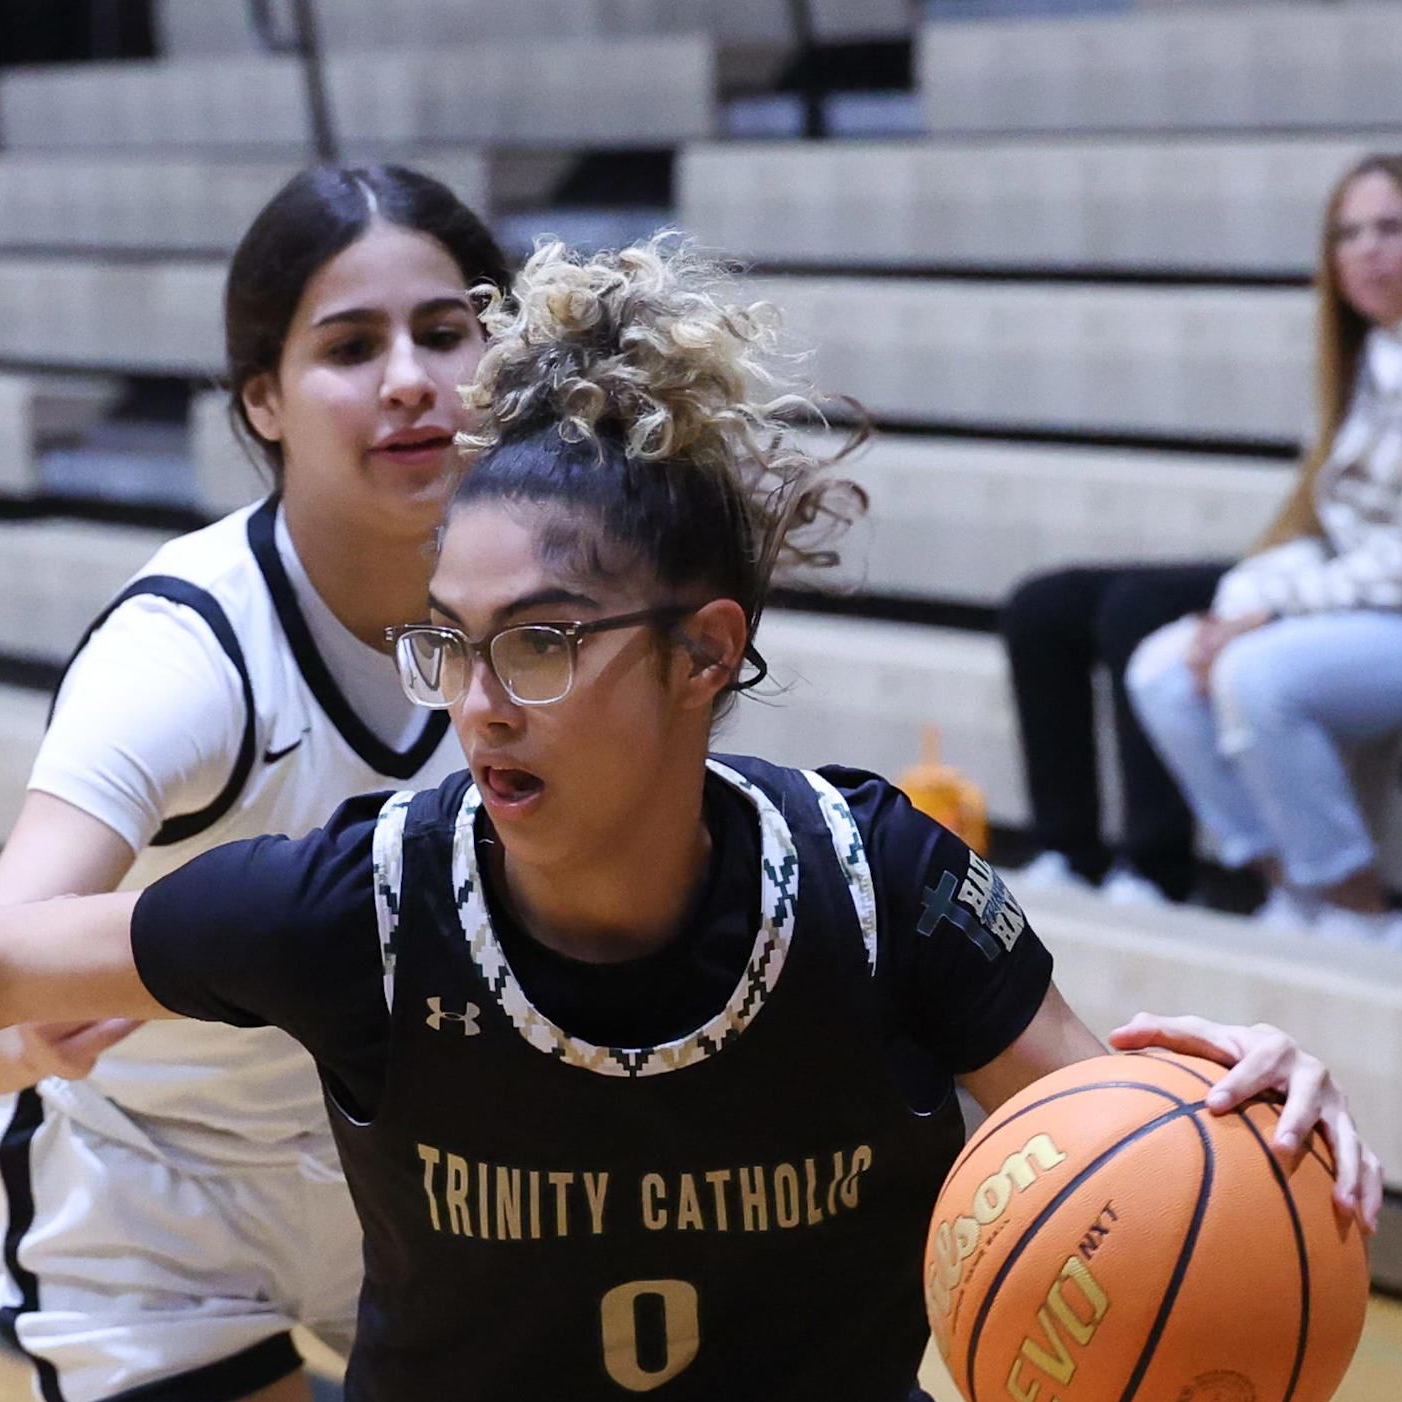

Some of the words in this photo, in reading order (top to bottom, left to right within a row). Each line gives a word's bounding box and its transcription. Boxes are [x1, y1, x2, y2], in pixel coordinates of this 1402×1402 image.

[417, 1143, 609, 1240] TRINITY
[641, 1145, 873, 1231] CATHOLIC
[926, 1132, 1067, 1352] ilson
[1078, 1199, 1118, 1260] NXT
[601, 1279, 700, 1392] 0
